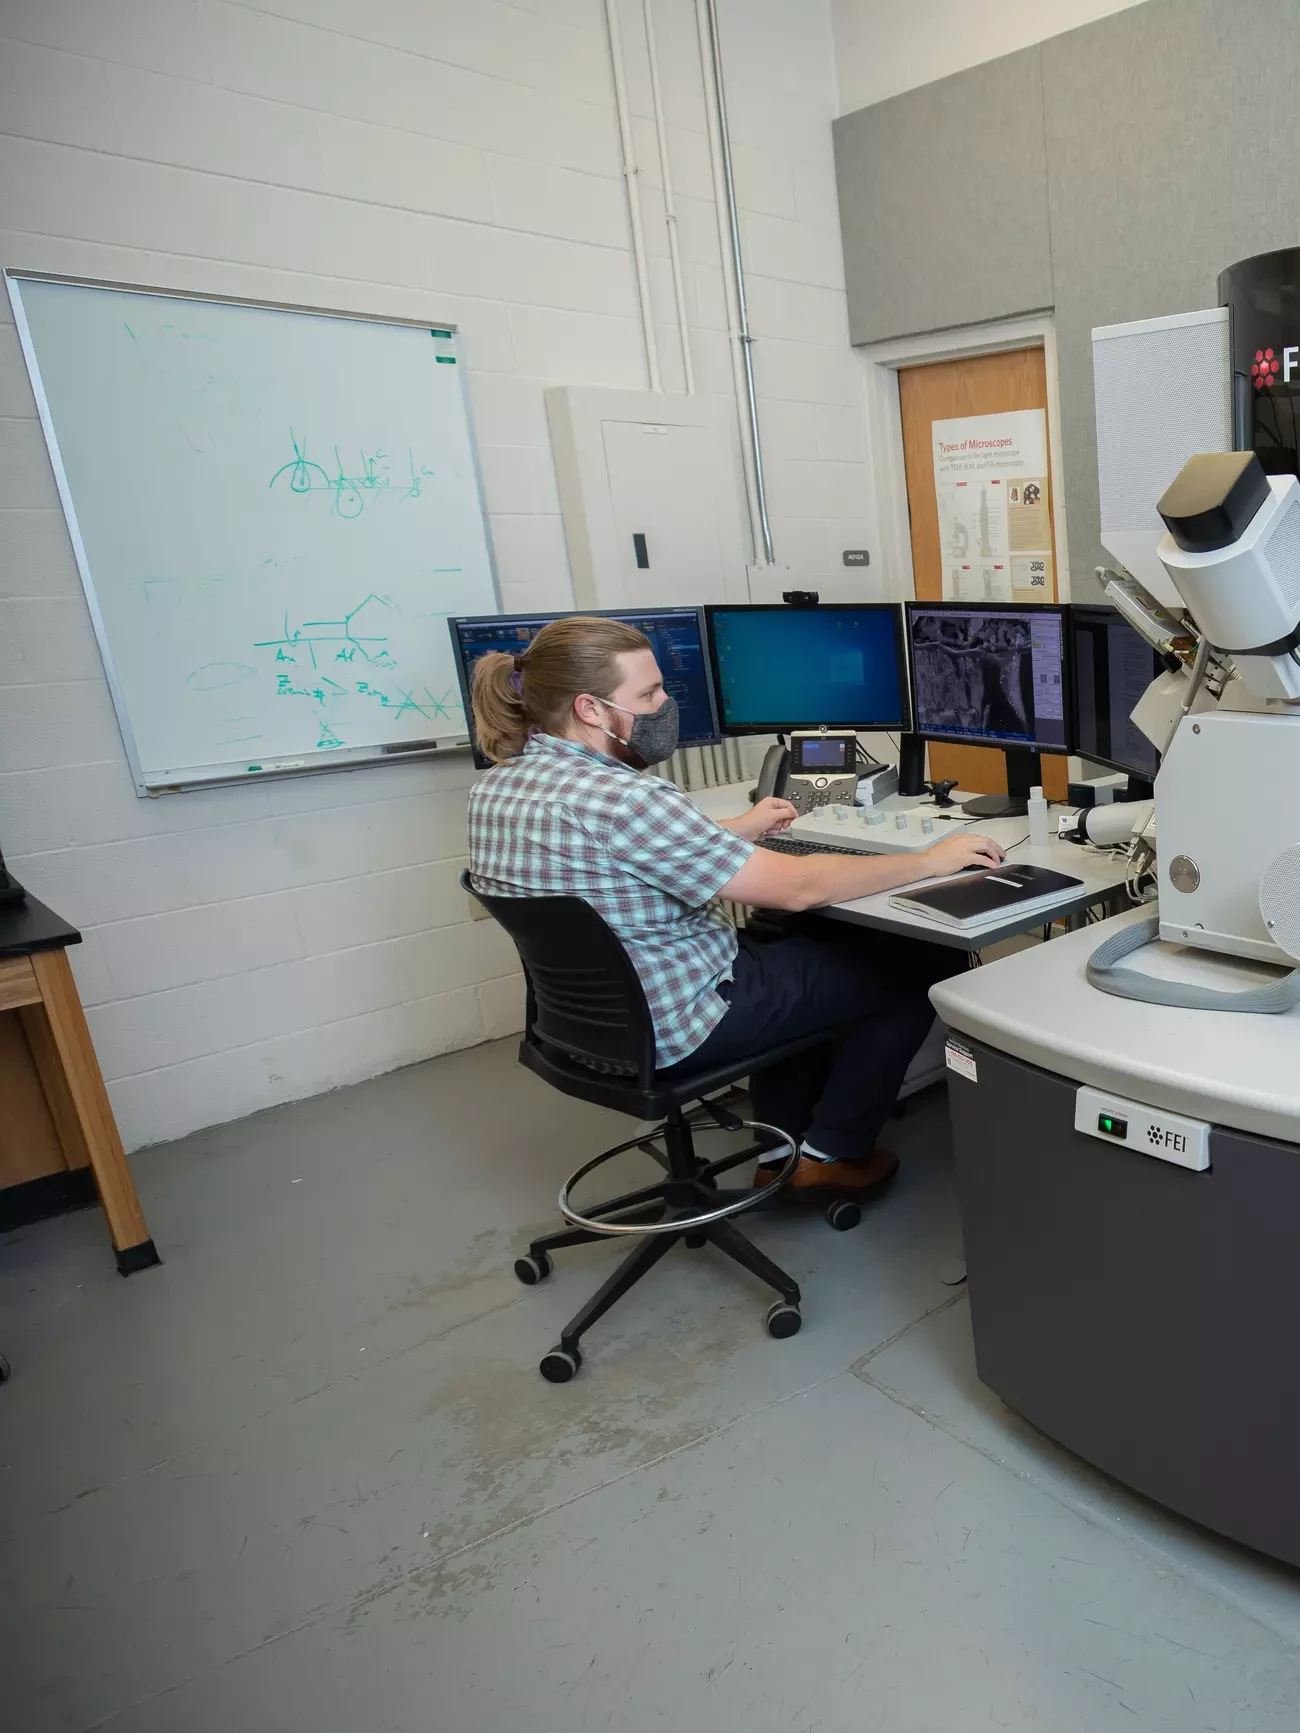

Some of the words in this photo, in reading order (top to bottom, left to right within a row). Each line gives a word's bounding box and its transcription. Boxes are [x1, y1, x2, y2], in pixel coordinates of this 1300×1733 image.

[938, 442, 959, 454] Types
[960, 440, 967, 450] of
[968, 437, 1013, 449] Microscopes
[1165, 1131, 1186, 1153] FEI
